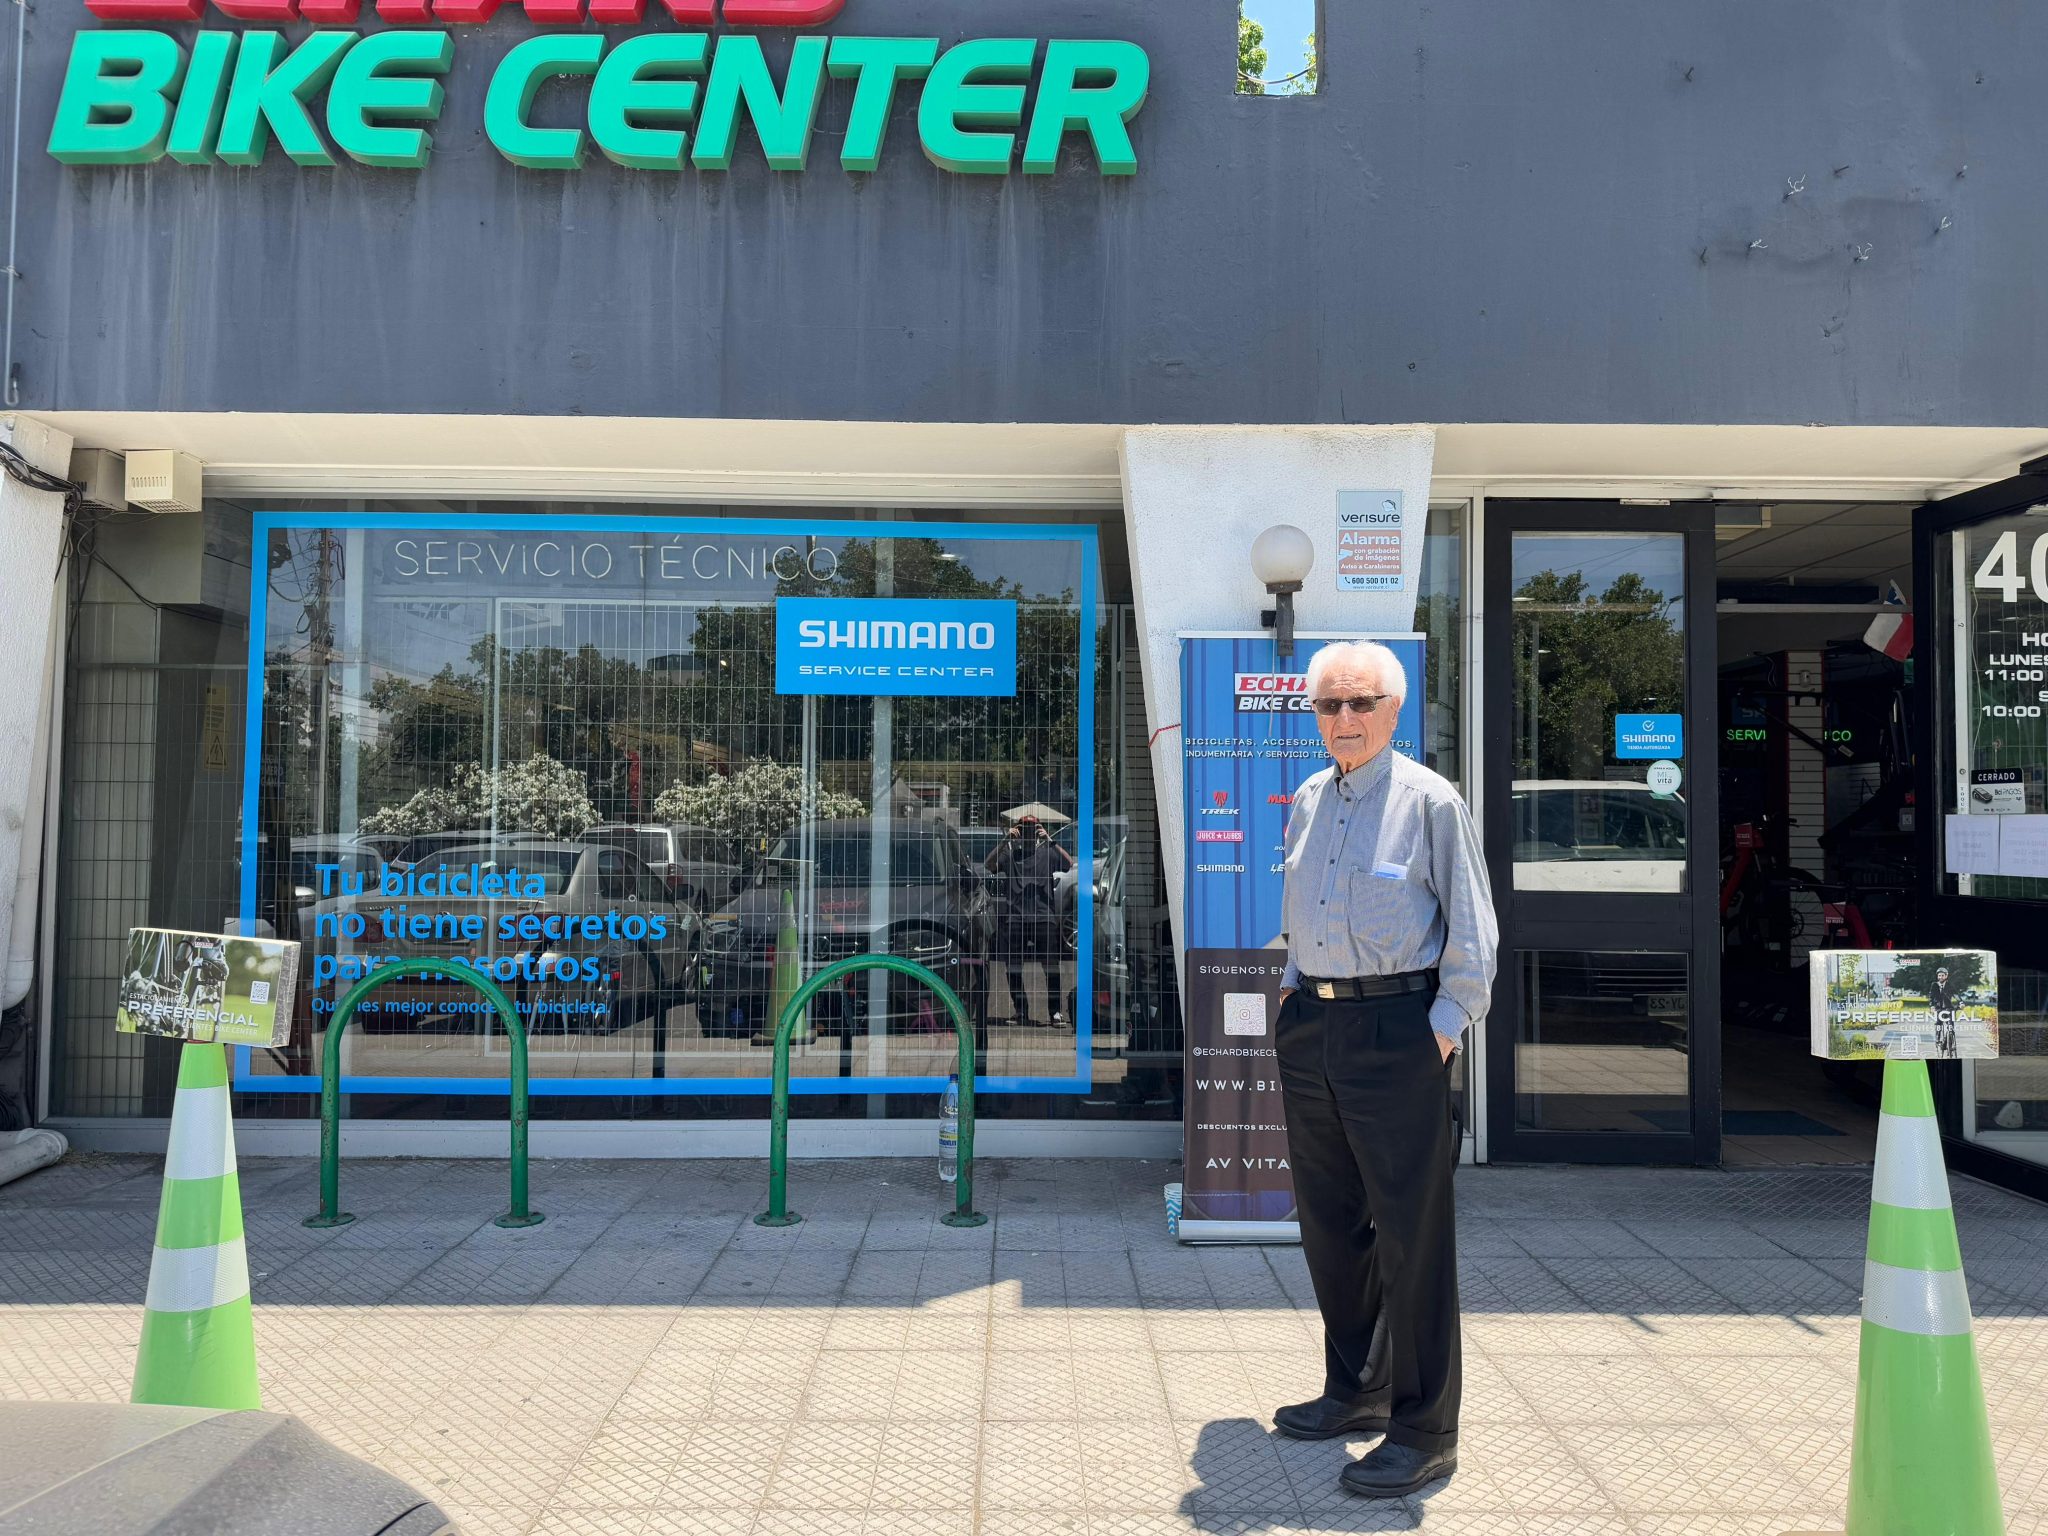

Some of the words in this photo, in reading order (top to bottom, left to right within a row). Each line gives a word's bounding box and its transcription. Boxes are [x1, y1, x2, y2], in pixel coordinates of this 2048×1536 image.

[48, 29, 455, 168] BIKE
[484, 33, 1150, 175] CENTER
[1341, 513, 1401, 523] verisure
[1340, 532, 1400, 545] Alarma
[1367, 547, 1400, 555] grabación
[394, 539, 613, 579] SERVICIO
[630, 534, 839, 582] TÉCNICO
[1365, 554, 1400, 562] imágenes
[799, 619, 995, 650] SHIMANO
[799, 665, 891, 676] SERVICE
[897, 665, 994, 677] CENTER
[1984, 669, 2044, 681] 11:00
[1238, 696, 1282, 711] BIKE
[1982, 705, 2041, 718] 10:00
[1621, 734, 1676, 743] SHIMANO
[1185, 750, 1254, 758] INDUMENTARIA
[1256, 750, 1264, 758] Y
[1265, 750, 1310, 758] SERVICIO
[1977, 772, 2016, 782] CERRADO
[1197, 832, 1216, 840] JUICE
[1196, 864, 1245, 872] SHIMANO
[314, 863, 364, 896] Tu
[379, 863, 546, 899] bicicleta
[314, 912, 366, 939] no
[378, 905, 484, 940] tiene
[497, 912, 667, 941] secretos
[385, 998, 433, 1016] mejor
[515, 1001, 532, 1014] tu
[128, 1000, 259, 1028] PREFERENCIAL
[1837, 1011, 1983, 1023] PREFERENCIAL
[1197, 1123, 1256, 1131] DESCUENTOS
[1205, 1157, 1232, 1169] AV
[1242, 1158, 1291, 1170] VITA
